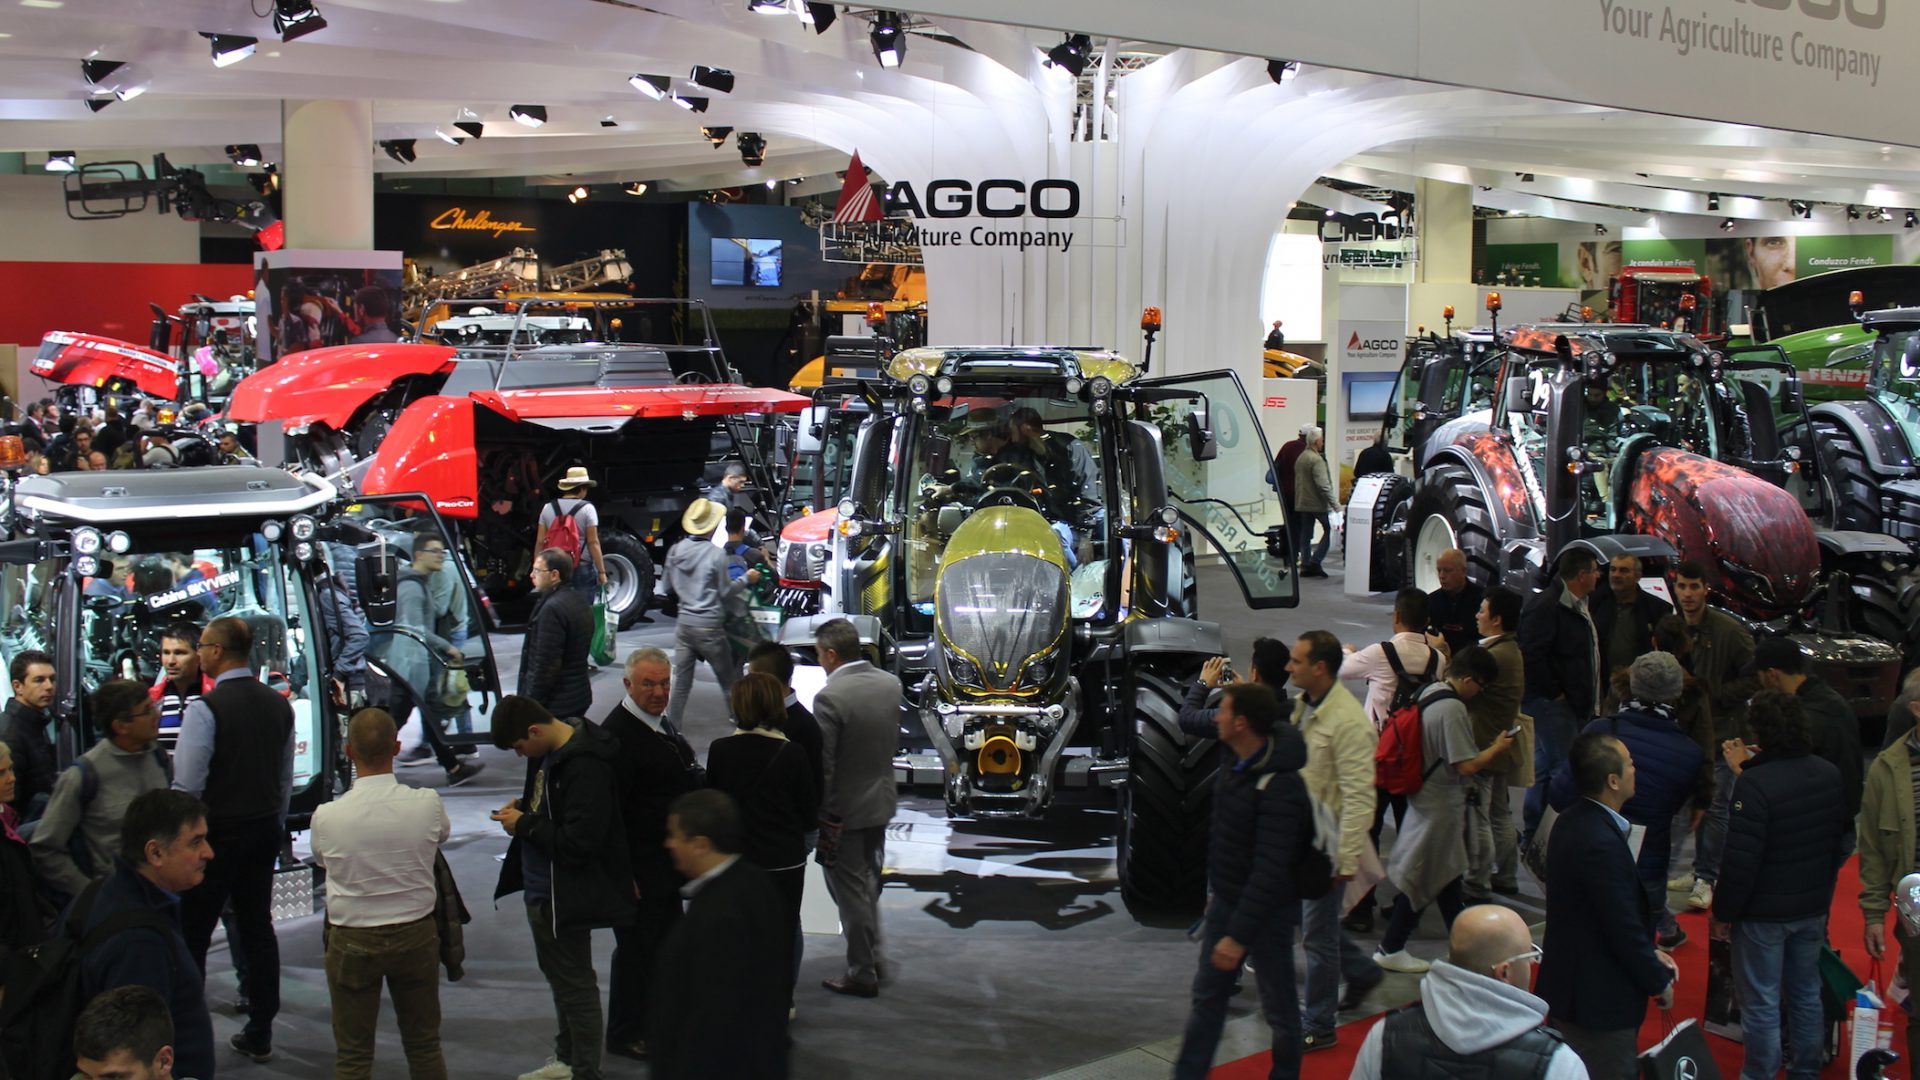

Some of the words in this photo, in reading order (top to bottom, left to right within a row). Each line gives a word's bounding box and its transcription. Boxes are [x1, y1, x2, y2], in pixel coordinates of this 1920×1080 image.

[1600, 0, 1653, 39] Your
[1659, 6, 1784, 61] Agriculture
[1791, 31, 1881, 87] Company
[884, 179, 1080, 218] AGCO
[430, 207, 536, 238] Challenger
[969, 226, 1074, 253] Company
[1808, 257, 1848, 266] Conduzco
[1362, 339, 1398, 350] AGCO
[149, 589, 188, 608] Cabine
[187, 570, 240, 596] SKYVIEW
